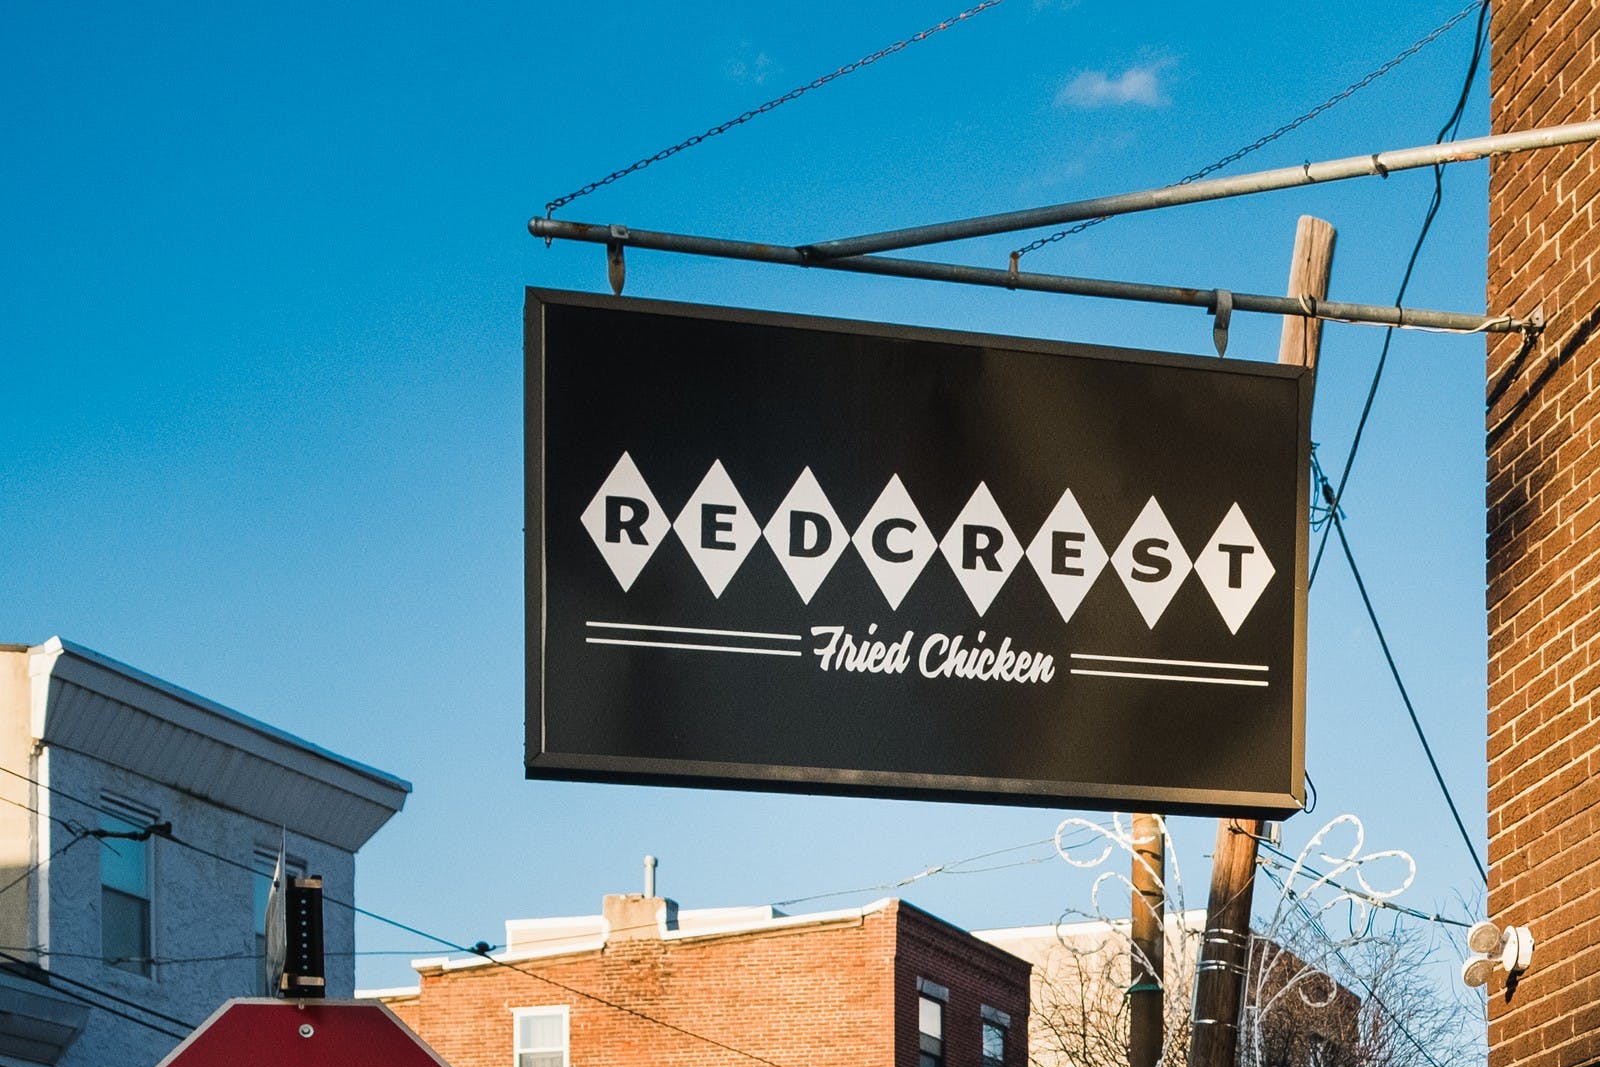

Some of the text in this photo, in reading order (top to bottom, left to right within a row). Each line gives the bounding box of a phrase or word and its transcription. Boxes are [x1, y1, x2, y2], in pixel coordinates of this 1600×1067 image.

[601, 493, 1258, 593] REDCREST
[810, 622, 1056, 684] Fried Chicken
